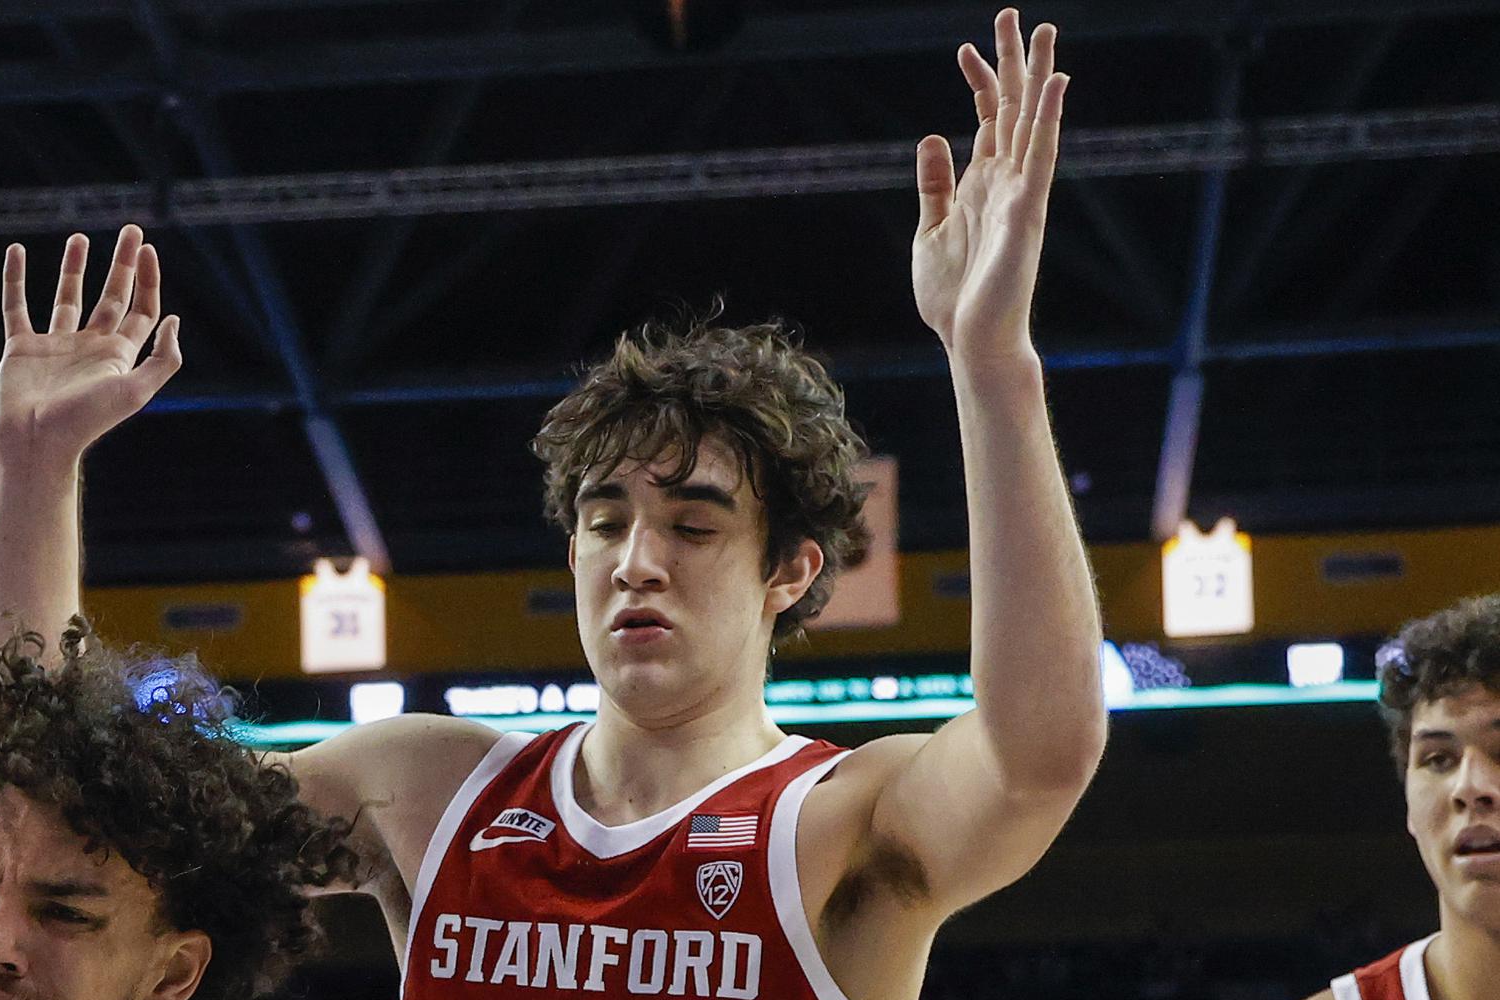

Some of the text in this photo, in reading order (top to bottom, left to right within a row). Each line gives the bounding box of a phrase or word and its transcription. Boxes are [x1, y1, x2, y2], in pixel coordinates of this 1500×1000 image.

[700, 864, 740, 896] PAC
[708, 884, 729, 906] 12
[430, 913, 763, 1000] STANFORD
